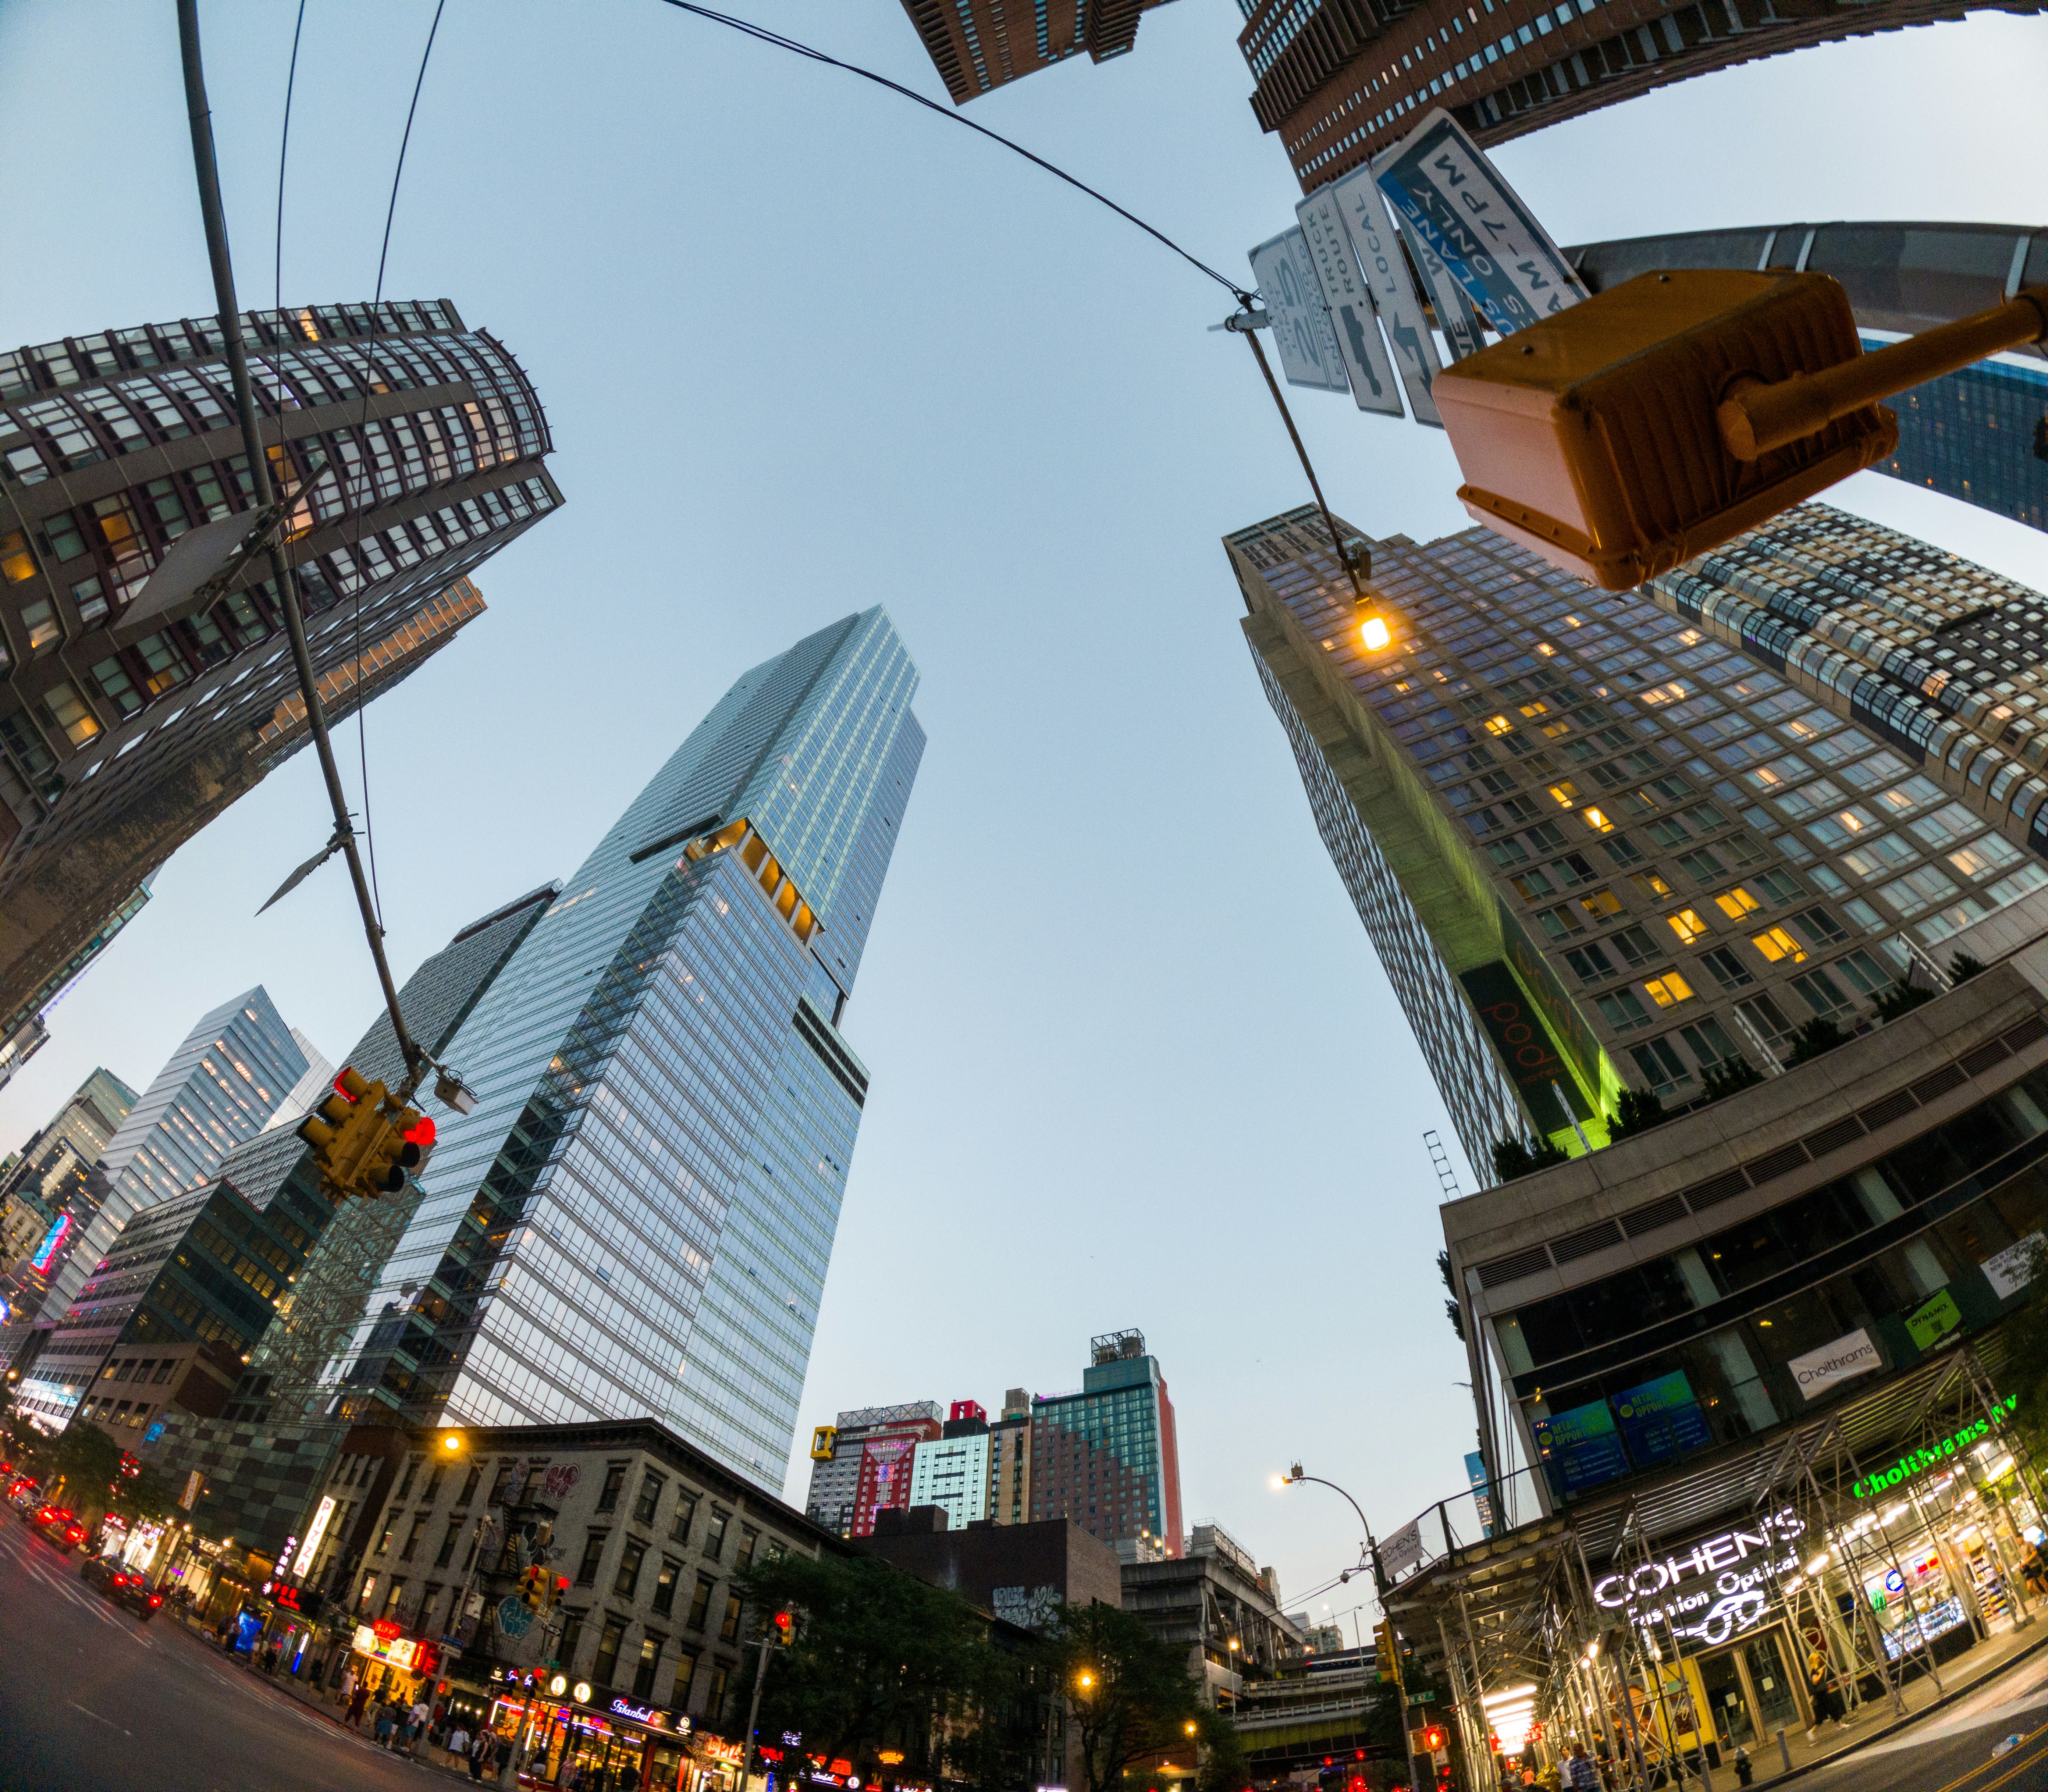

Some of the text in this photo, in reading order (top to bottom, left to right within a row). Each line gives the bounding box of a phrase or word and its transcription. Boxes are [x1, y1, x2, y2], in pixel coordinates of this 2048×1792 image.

[1307, 212, 1338, 296] TRUCK
[1318, 203, 1355, 293] ROUTE
[1355, 193, 1396, 293] LOCAL
[1402, 199, 1475, 283] LANE
[1413, 188, 1493, 276] ONLY
[1434, 155, 1563, 313] AM-7PM
[1264, 294, 1283, 345] CITY
[1266, 280, 1293, 356] SPEED
[1273, 255, 1321, 366] 25
[1273, 285, 1297, 348] LIMIT
[1298, 243, 1344, 376] ENFORCED
[1301, 271, 1329, 349] PHOTO
[1485, 298, 1516, 334] US
[1481, 1002, 1557, 1067] pod
[1912, 1302, 1949, 1327] DYNAMIX
[1798, 1344, 1873, 1383] Choithrams
[1854, 1419, 1989, 1498] Choithrams
[294, 1500, 331, 1575] PIZZA
[1383, 1530, 1417, 1560] COHEN'S
[1399, 1540, 1419, 1558] Optical
[1594, 1507, 1805, 1607] COHEN'S
[1716, 1546, 1800, 1594] Optical
[609, 1698, 654, 1722] Istanbul
[1496, 1731, 1544, 1749] MARKET
